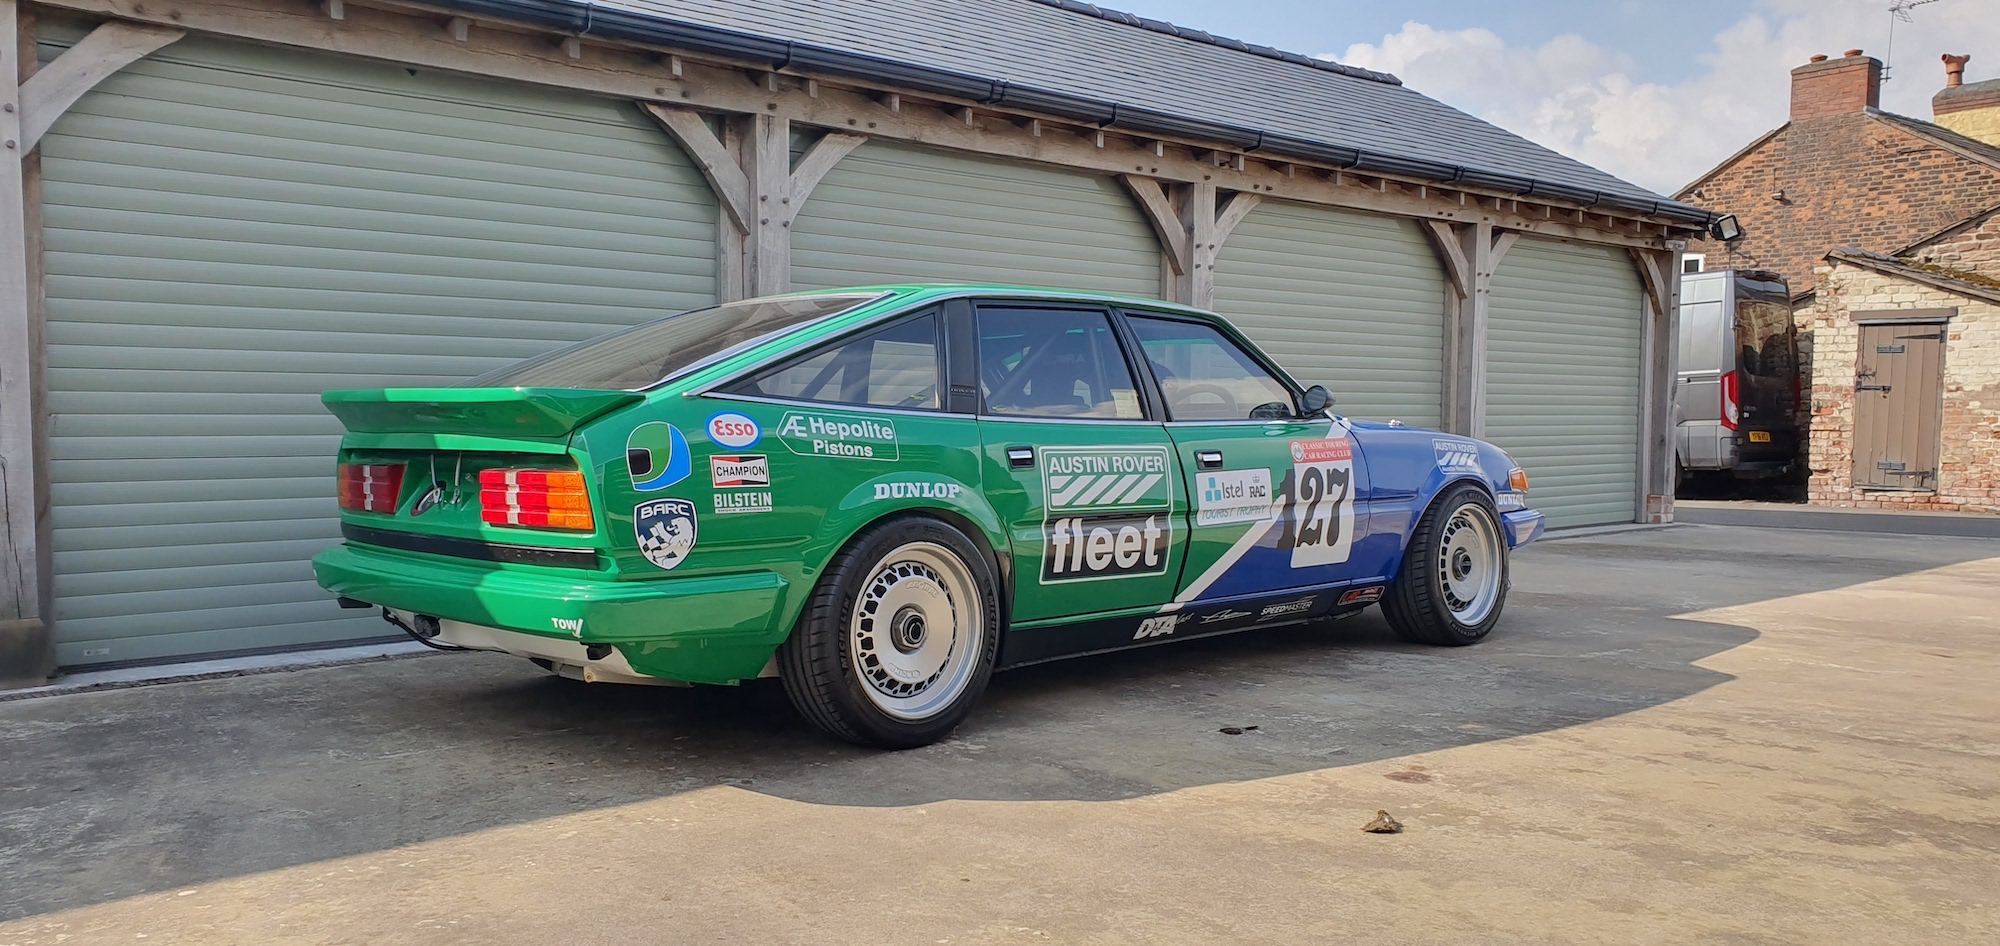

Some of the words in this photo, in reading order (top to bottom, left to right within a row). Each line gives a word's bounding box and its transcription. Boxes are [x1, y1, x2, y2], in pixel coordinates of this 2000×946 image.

[809, 417, 894, 440] Hepolite
[813, 439, 874, 457] Pistons
[1302, 442, 1324, 450] CLASSIC
[1325, 440, 1349, 449] TOURING
[1435, 442, 1457, 452] AUSTIN
[1457, 444, 1477, 453] ROVER
[1304, 452, 1315, 460] CAR
[1316, 451, 1336, 459] RACING
[716, 465, 765, 477] CHAMPION
[1049, 456, 1109, 473] AUSTIN
[1112, 456, 1164, 472] ROVER
[874, 483, 960, 499] DUNLOP
[1222, 481, 1244, 499] Istel
[1249, 485, 1266, 498] RAC
[714, 492, 772, 507] BILSTEIN
[641, 503, 690, 519] BARC
[1202, 507, 1234, 520] TOURIST
[1235, 504, 1269, 517] TROPHY
[1277, 467, 1349, 550] 127
[1052, 514, 1160, 573] fleet
[1261, 600, 1313, 615] SPEEDMASTER
[551, 617, 577, 631] TOW
